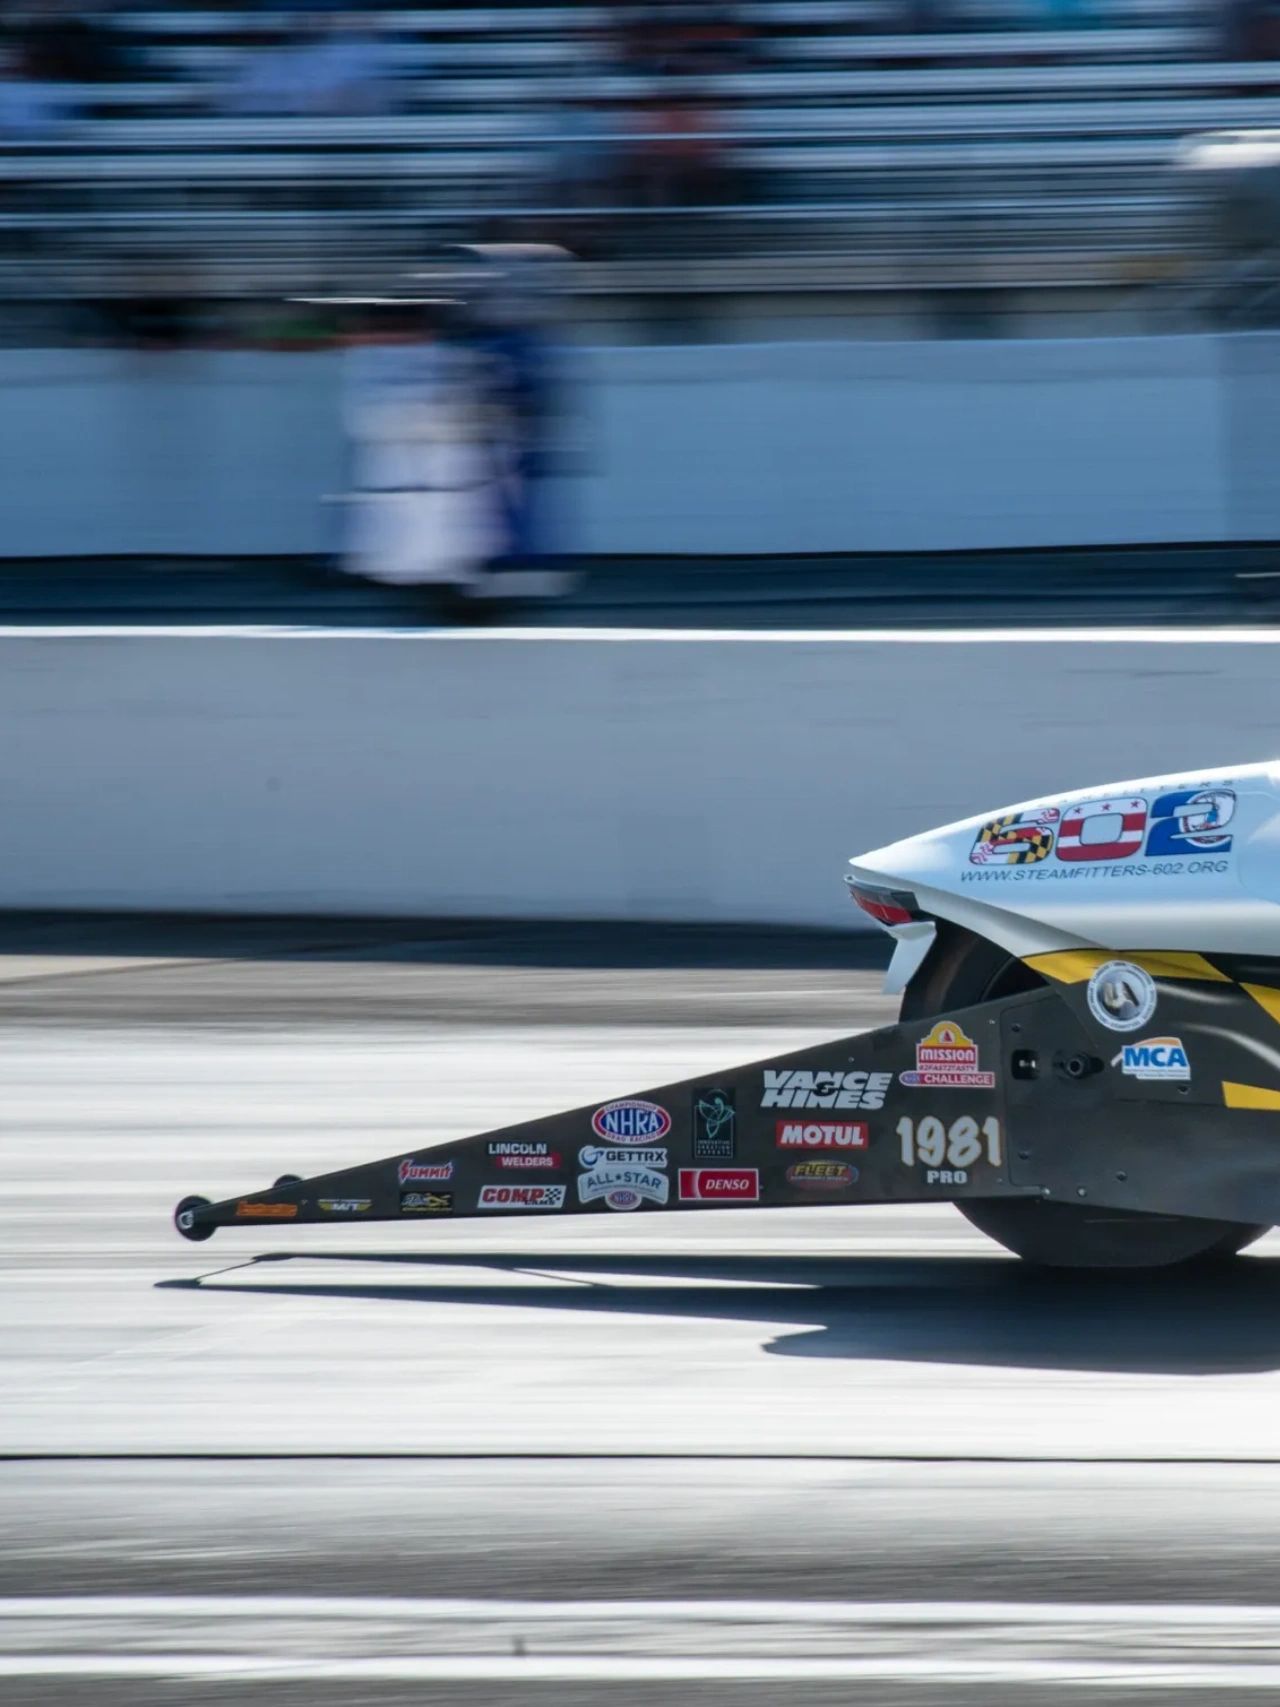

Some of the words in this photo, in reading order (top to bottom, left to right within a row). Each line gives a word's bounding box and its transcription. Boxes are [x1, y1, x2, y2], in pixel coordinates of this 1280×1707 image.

[968, 788, 1238, 866] 602
[960, 860, 1229, 883] WWW.STEAMFITTERS-602.ORG
[1124, 1046, 1187, 1068] MCA
[763, 1070, 893, 1091] VANCE
[924, 1074, 991, 1085] CHALLENGE
[760, 1088, 886, 1110] HINES
[605, 1108, 660, 1135] NHRA
[781, 1125, 864, 1145] MOTUL
[896, 1115, 1001, 1167] 1981
[488, 1143, 547, 1154] LINCOLN
[606, 1150, 665, 1162] GETTRX
[501, 1156, 554, 1166] WELDERS
[794, 1163, 846, 1176] FLEET
[587, 1172, 614, 1189] ALL
[623, 1171, 662, 1189] STAR
[705, 1178, 750, 1190] DENSO
[927, 1170, 968, 1184] PRO
[482, 1187, 545, 1204] COMP
